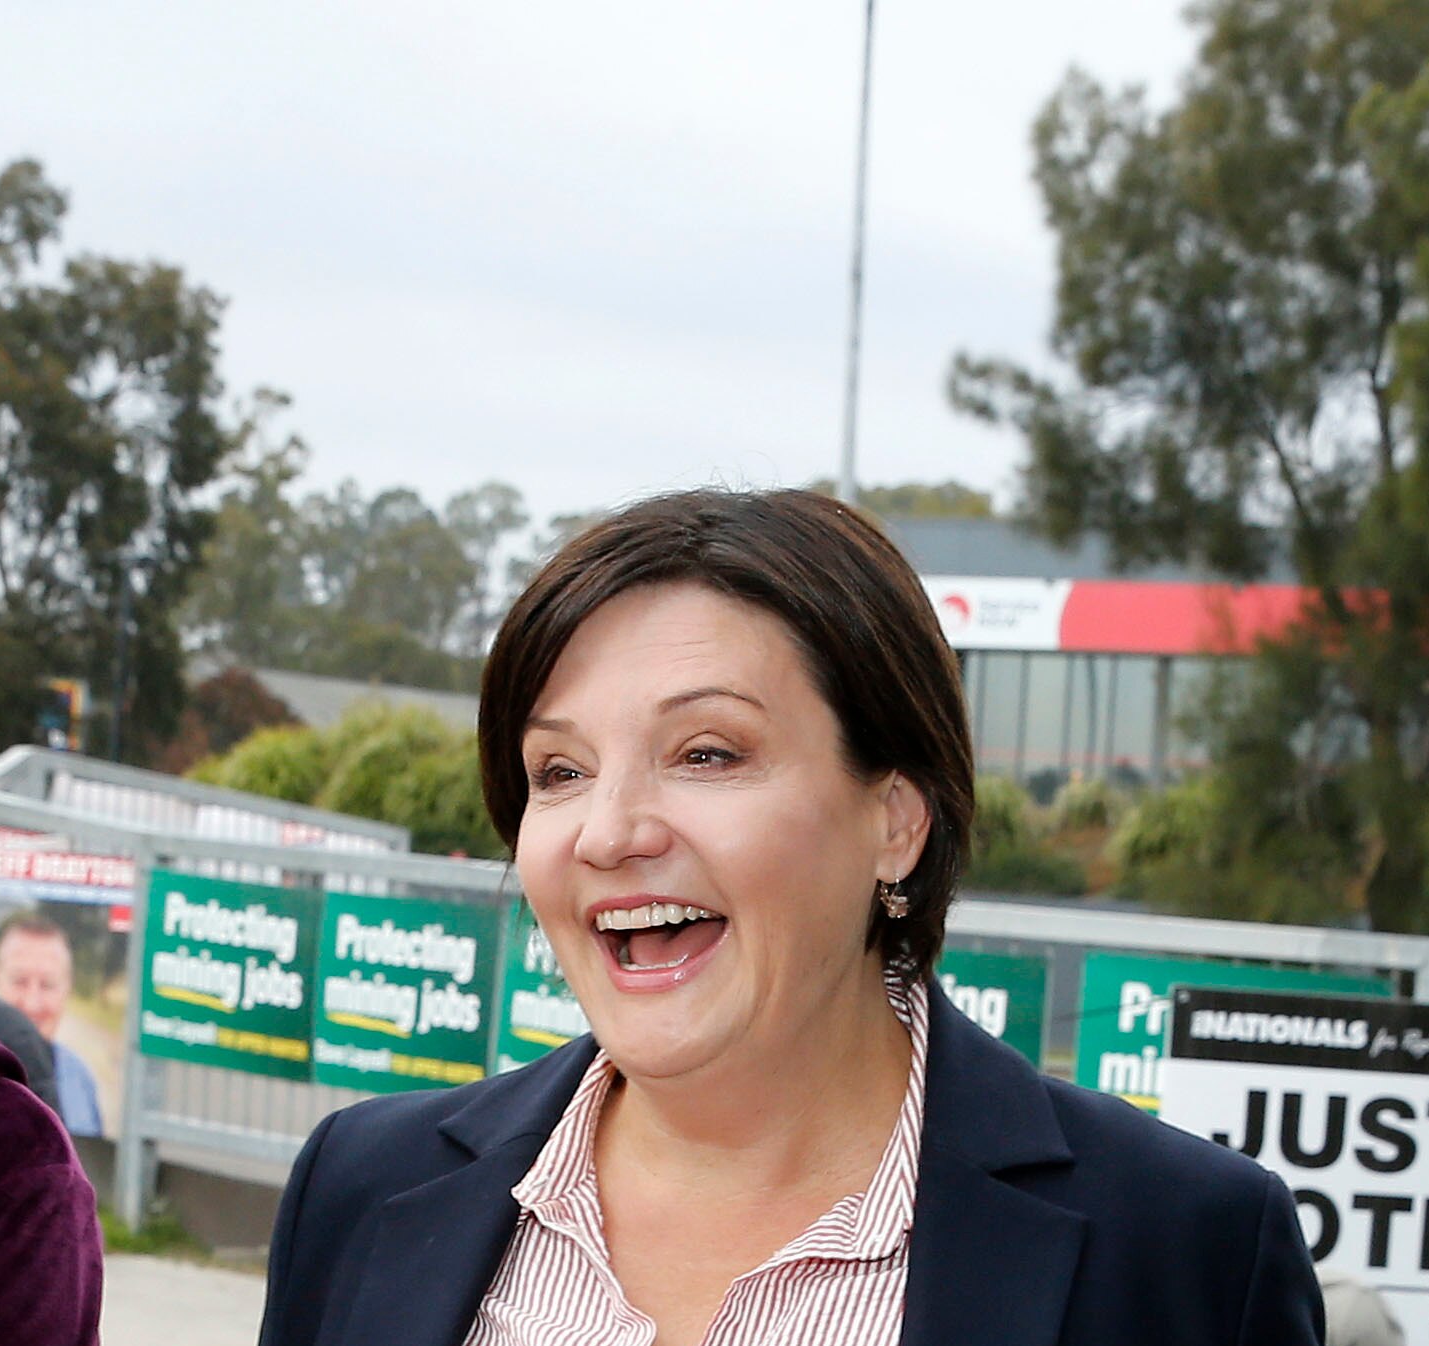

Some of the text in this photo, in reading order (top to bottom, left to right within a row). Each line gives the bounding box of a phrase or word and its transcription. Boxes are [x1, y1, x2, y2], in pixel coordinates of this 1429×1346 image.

[164, 891, 298, 964] Protecting
[336, 913, 477, 984] Protecting
[152, 945, 303, 1010] mining jobs
[325, 969, 481, 1035] mining jobs
